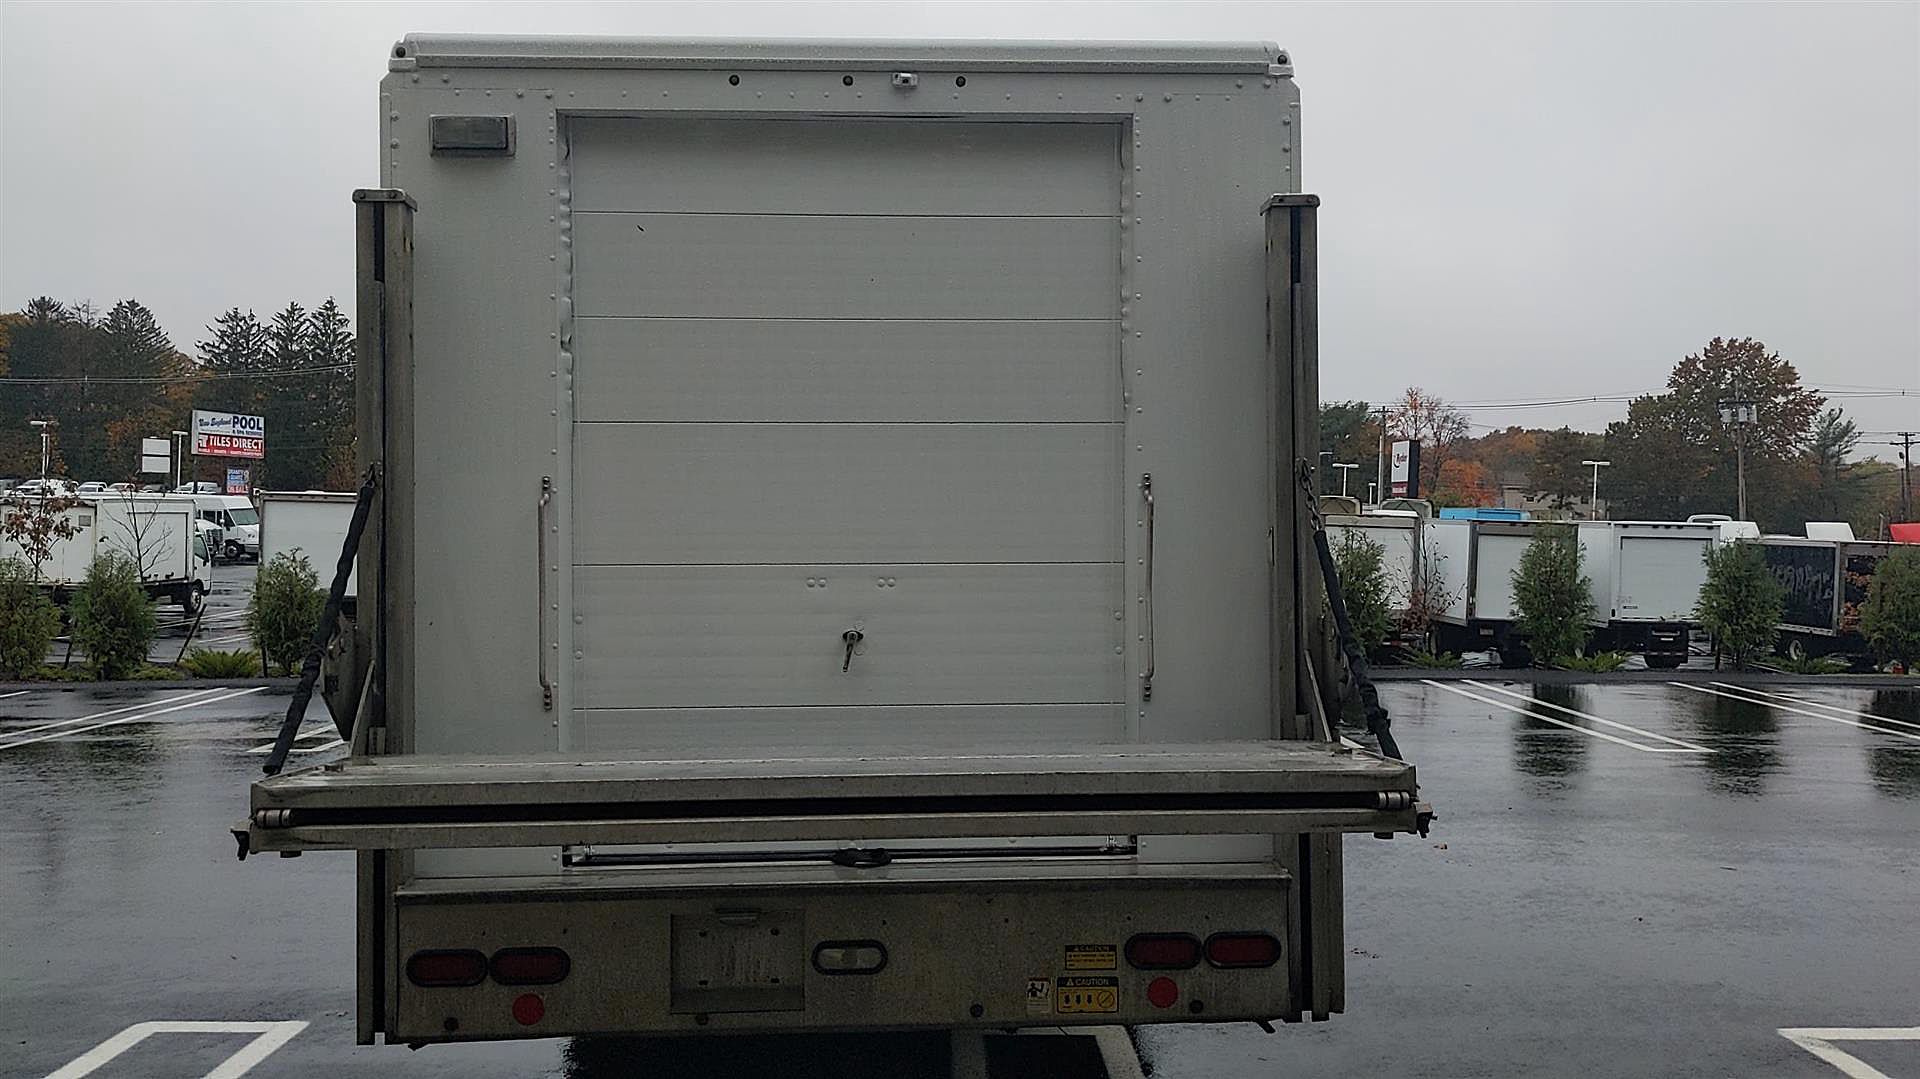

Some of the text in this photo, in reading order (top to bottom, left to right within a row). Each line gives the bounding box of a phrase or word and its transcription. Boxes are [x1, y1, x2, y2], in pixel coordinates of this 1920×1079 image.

[232, 415, 262, 430] POOL
[209, 436, 262, 450] TILES DIRECT
[1075, 978, 1109, 986] CAUTION
